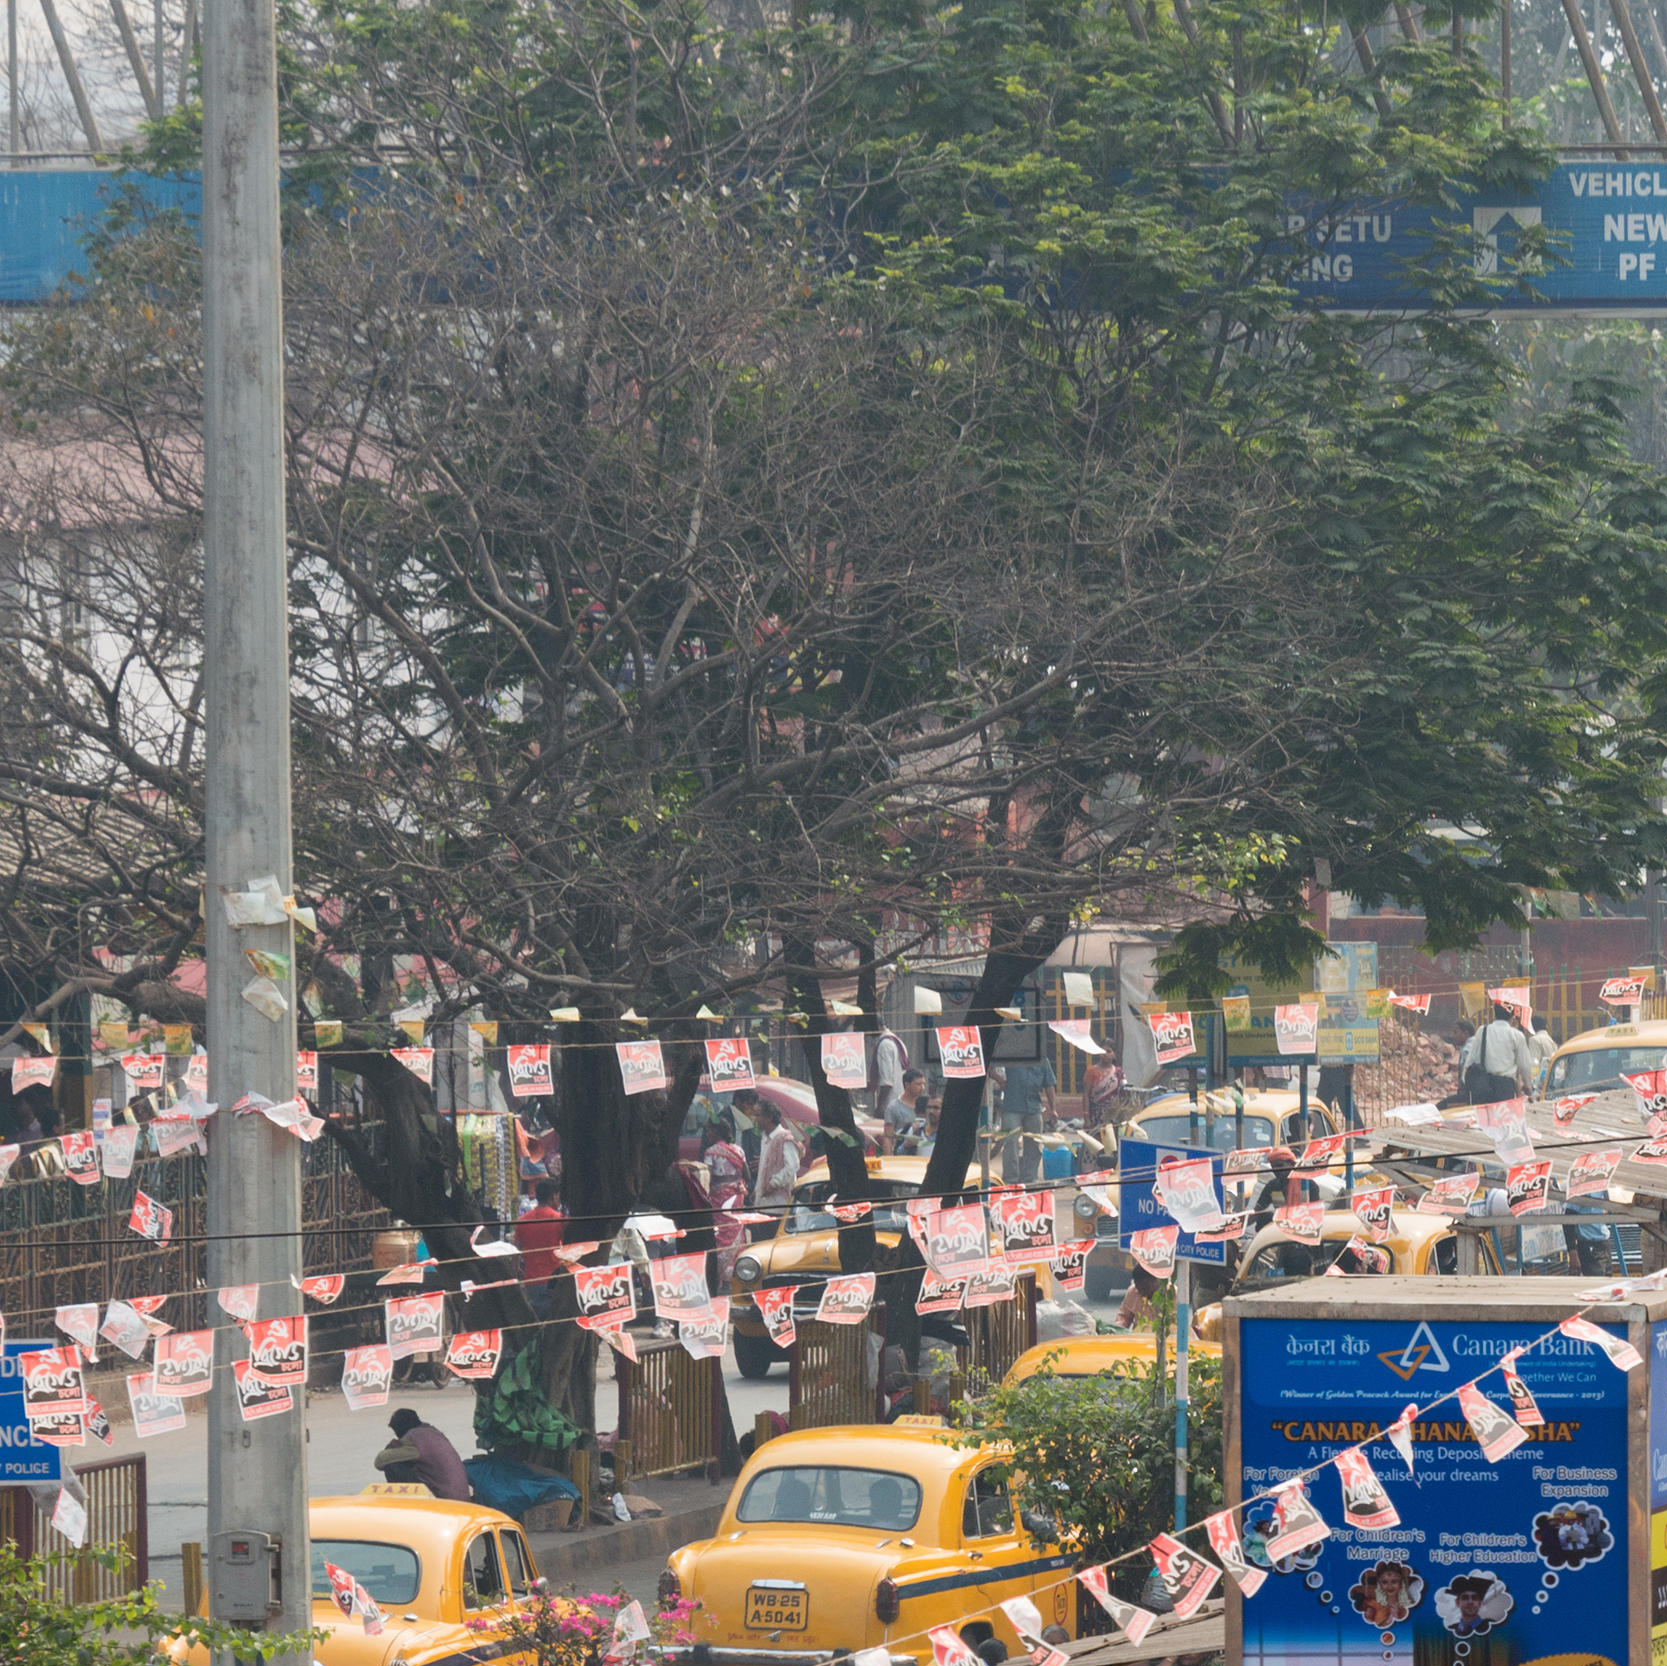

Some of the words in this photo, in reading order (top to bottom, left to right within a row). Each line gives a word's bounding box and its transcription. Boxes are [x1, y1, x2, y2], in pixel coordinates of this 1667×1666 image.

[1619, 253, 1655, 282] PF
[1453, 1334, 1531, 1356] Canara
[1540, 1335, 1596, 1356] Bank
[1450, 1469, 1499, 1483] dreams
[1533, 1467, 1554, 1481] For
[1557, 1467, 1617, 1481] Business
[371, 1484, 419, 1494] TAXI
[1541, 1485, 1609, 1499] Expansion
[1330, 1530, 1354, 1543] For
[1356, 1529, 1426, 1543] Children's
[1440, 1533, 1460, 1546] For
[1462, 1532, 1527, 1547] Children's
[1347, 1547, 1410, 1562] Marriage
[1429, 1550, 1471, 1564] Higher
[1474, 1550, 1537, 1563] Education
